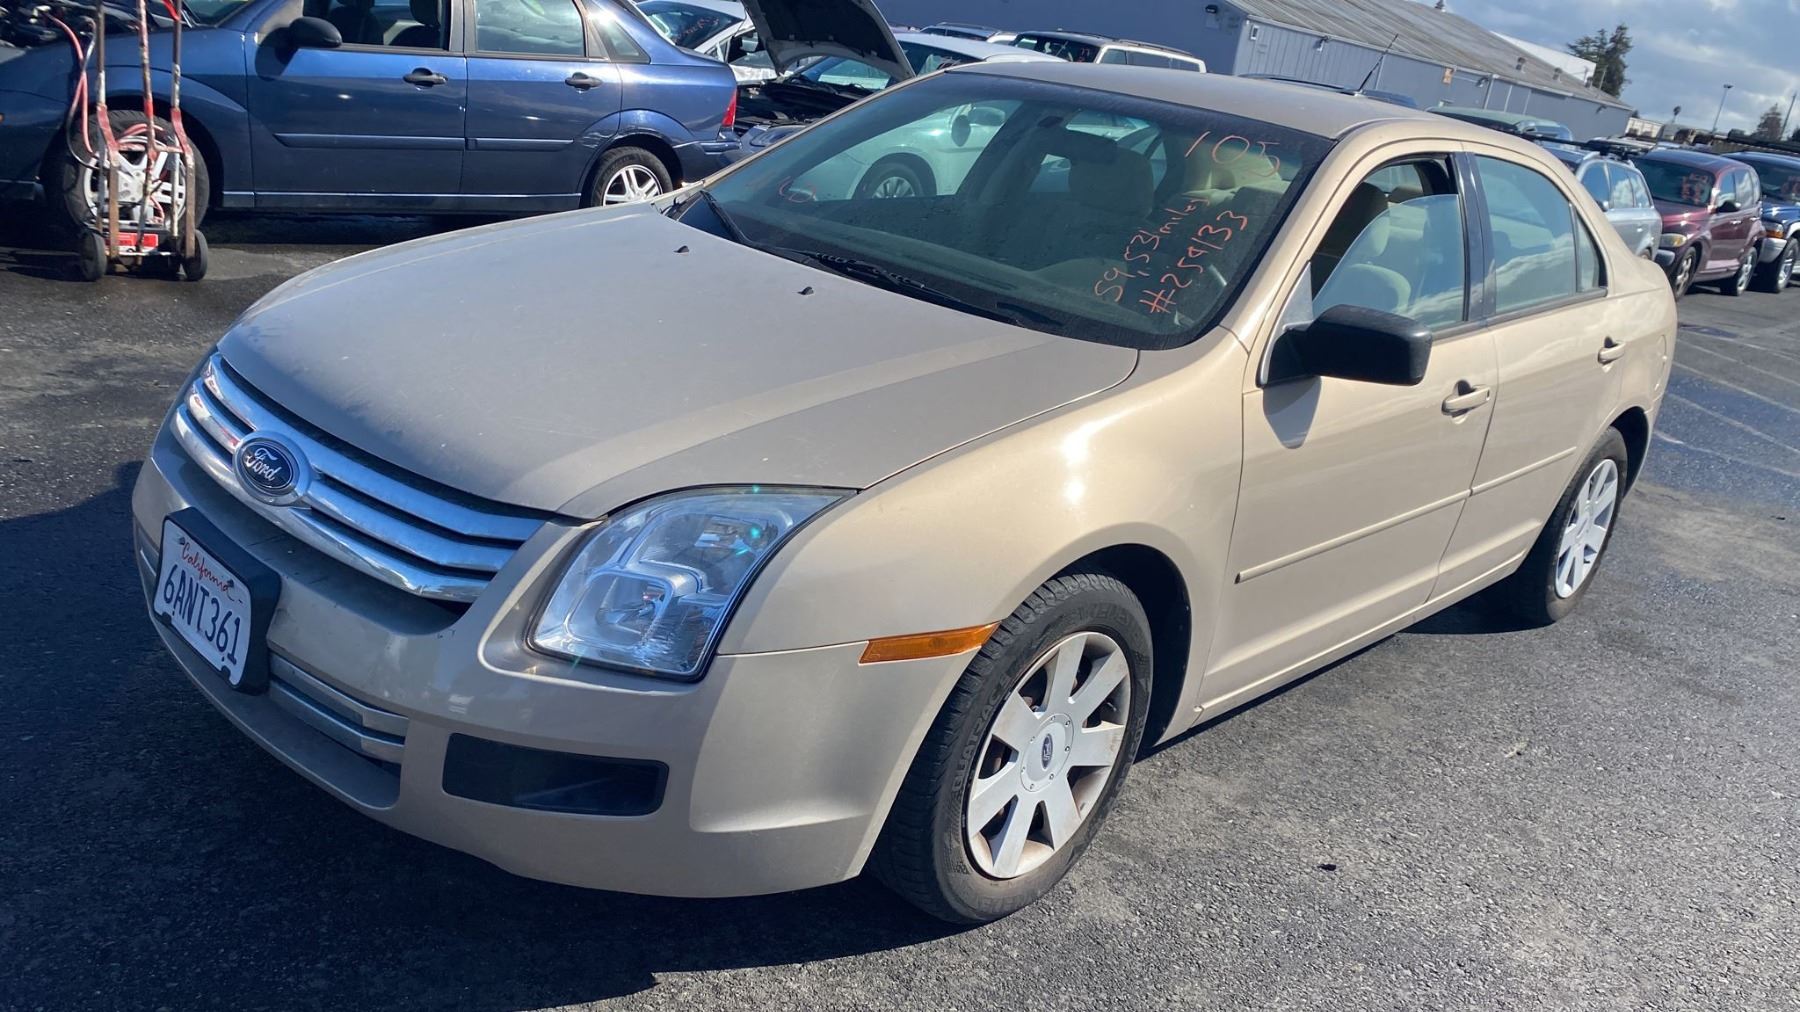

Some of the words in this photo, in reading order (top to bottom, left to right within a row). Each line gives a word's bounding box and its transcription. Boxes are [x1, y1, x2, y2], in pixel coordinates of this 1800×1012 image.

[1184, 131, 1280, 178] 105
[245, 447, 282, 481] Ford
[181, 541, 235, 601] California
[163, 564, 241, 665] 6ANT361
